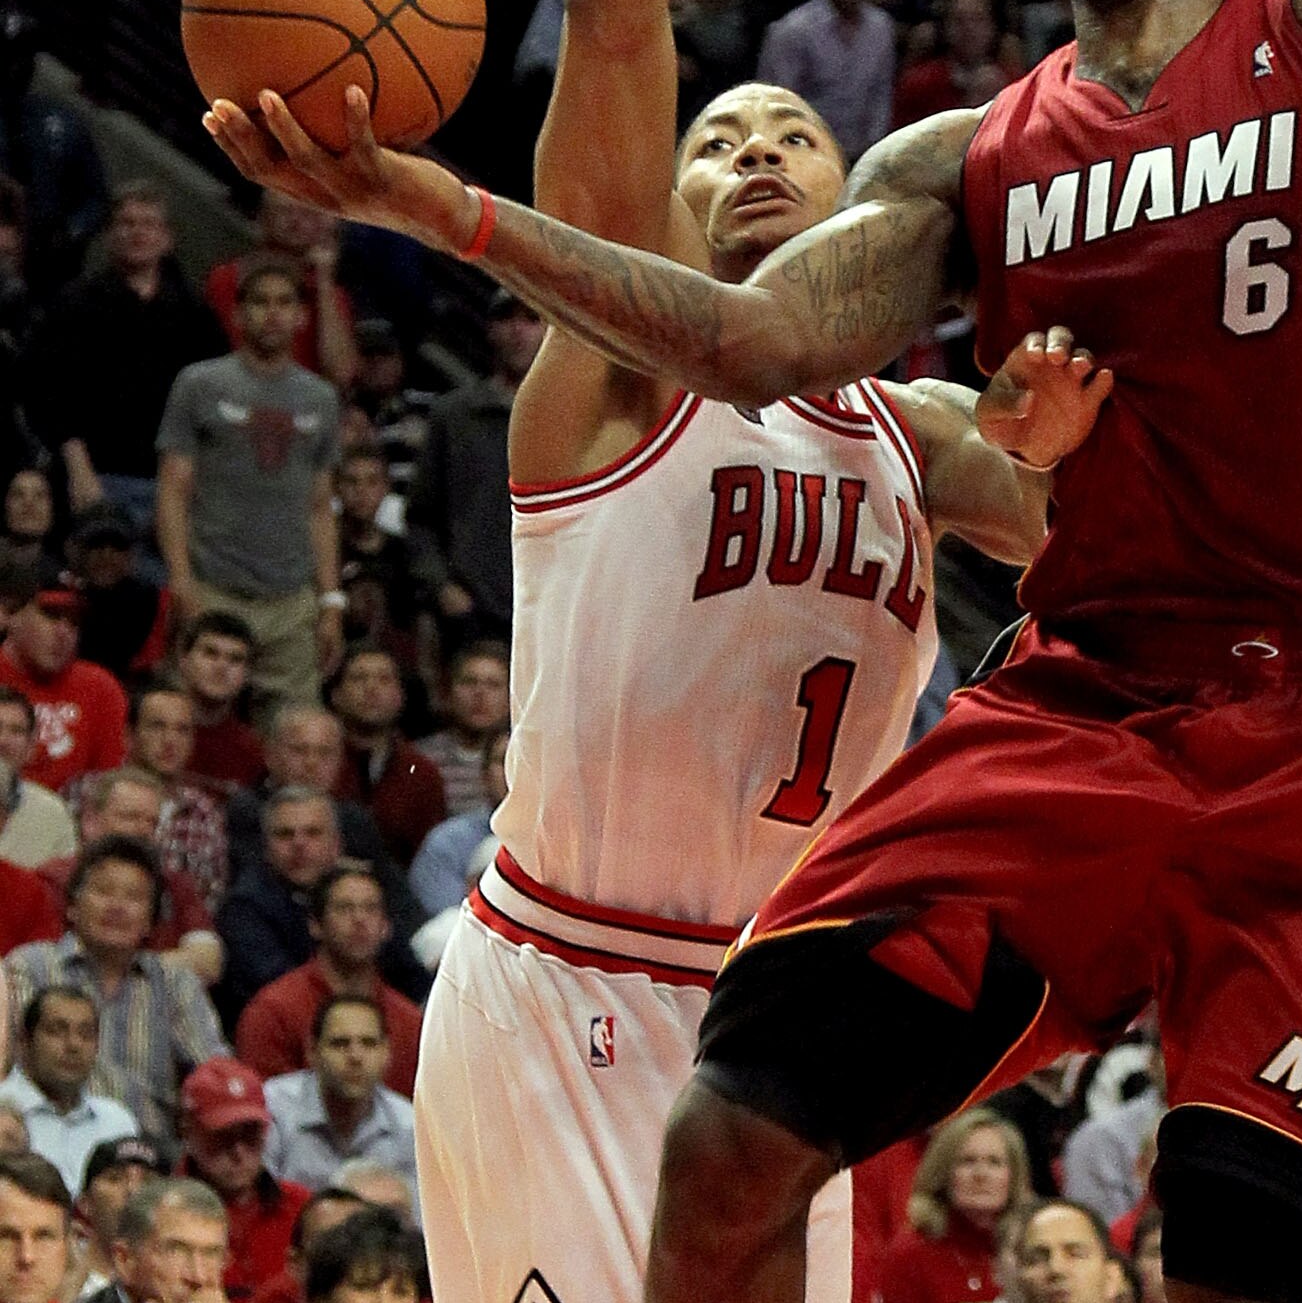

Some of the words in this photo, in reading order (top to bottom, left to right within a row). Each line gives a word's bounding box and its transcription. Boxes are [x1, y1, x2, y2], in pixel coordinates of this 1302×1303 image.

[1005, 111, 1296, 266] MIAMI
[1223, 217, 1292, 335] 6
[693, 465, 926, 633] BULL
[760, 656, 857, 827] 1
